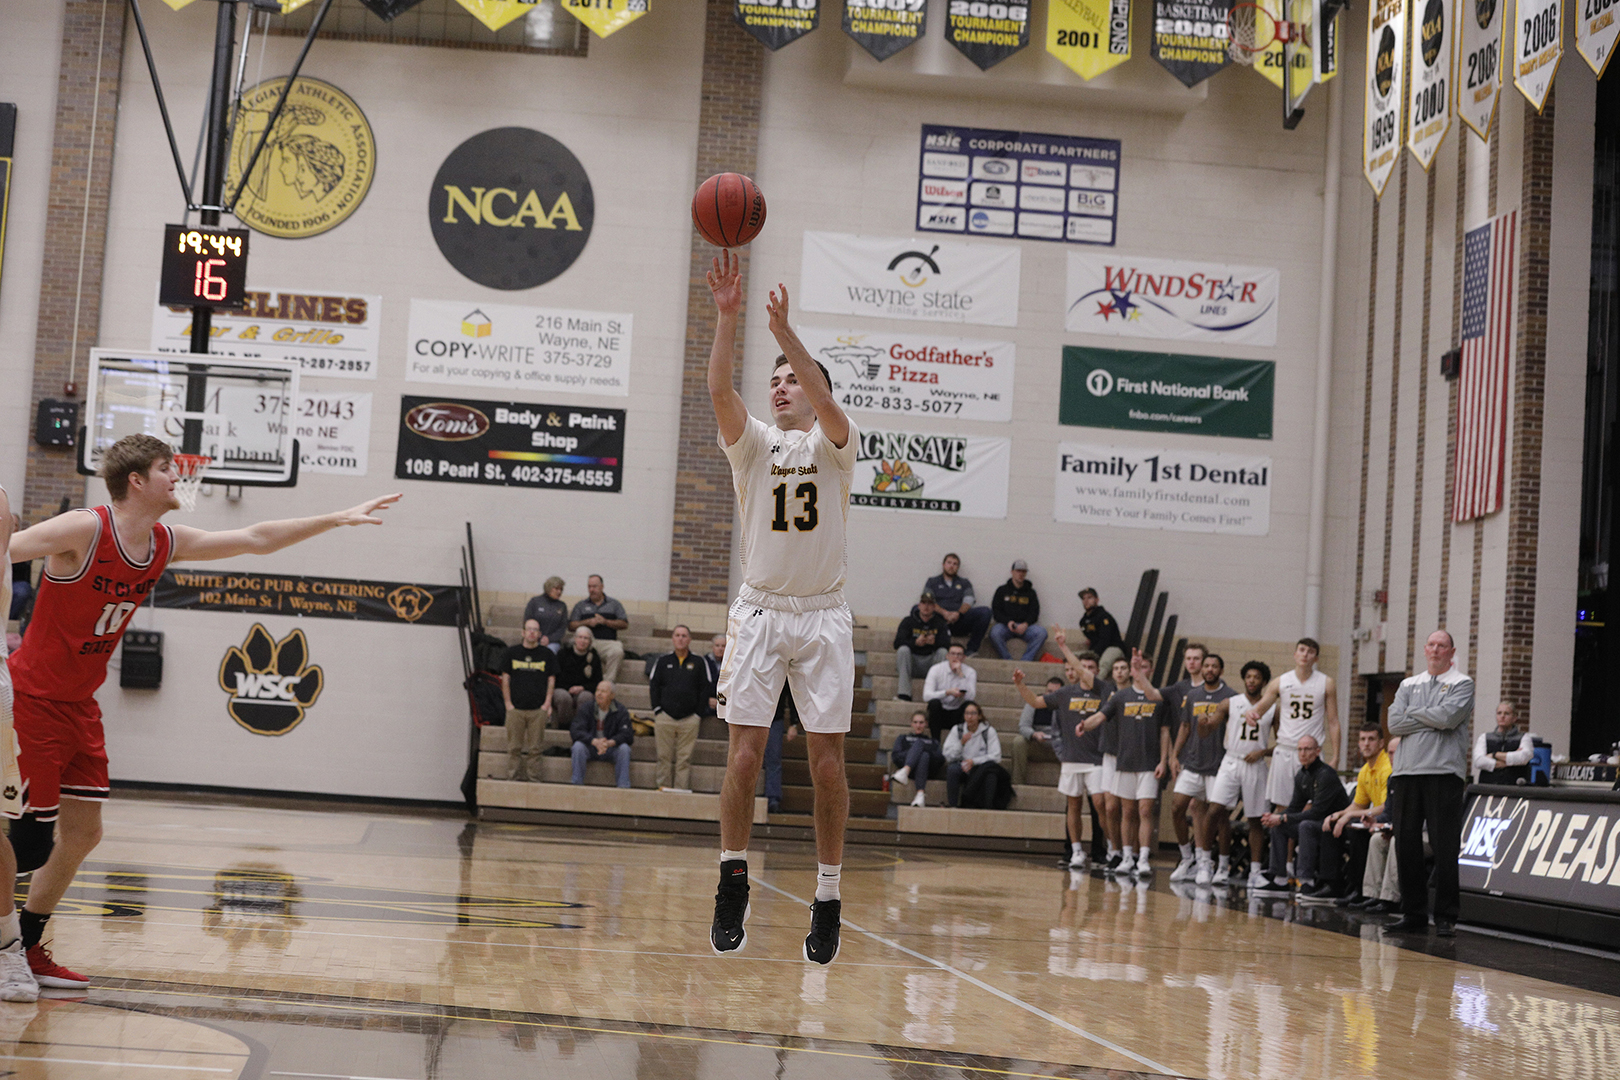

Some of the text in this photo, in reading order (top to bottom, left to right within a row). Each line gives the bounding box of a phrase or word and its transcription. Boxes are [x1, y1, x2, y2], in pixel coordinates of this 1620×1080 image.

[738, 4, 816, 19] TOURNAMENT
[847, 6, 924, 24] TOURNAMENT
[950, 0, 1028, 21] 2006
[1156, 2, 1229, 22] BASKETBALL
[745, 16, 813, 30] CHAMPIONS
[851, 20, 917, 38] CHAMPIONS
[950, 15, 1027, 34] TOURNAMENT
[1155, 18, 1231, 39] 2000
[1523, 2, 1557, 58] 2006
[953, 29, 1020, 47] CHAMPIONS
[1056, 29, 1099, 48] 2001
[1155, 33, 1230, 51] TOURNAMENT
[1158, 47, 1224, 64] CHAMPIONS
[1467, 37, 1498, 90] 2005
[1414, 78, 1445, 127] 2000
[297, 83, 354, 121] ATHLETIC
[337, 124, 367, 211] ASSOCIATION
[968, 138, 1047, 155] CORPORATE
[1049, 145, 1117, 160] PARTNERS
[924, 185, 964, 198] Wilson
[443, 184, 583, 231] NCAA
[250, 207, 331, 231] FOUNDED 1906
[928, 215, 957, 225] NSIC
[178, 231, 242, 257] 19:44
[193, 258, 228, 301] 16
[847, 286, 973, 311] wayne state
[1200, 305, 1227, 316] LINES
[238, 325, 261, 340] &
[271, 328, 345, 345] Grille
[535, 314, 625, 335] 216 Main St.
[539, 332, 620, 351] Wayne, NE
[543, 351, 612, 369] 375-3729
[889, 343, 994, 368] Godfather's
[412, 362, 623, 388] For all your copying & office supply needs.
[888, 364, 940, 385] Pizza
[850, 383, 884, 393] Main
[888, 386, 904, 395] St.
[929, 388, 979, 401] Wayne,
[983, 393, 1000, 402] NE
[1116, 377, 1148, 394] First
[1150, 380, 1211, 399] National
[1213, 385, 1249, 402] Bank
[842, 393, 963, 415] 402-833-5077
[413, 408, 480, 435] Tom's
[494, 407, 617, 431] Body & Paint
[1129, 409, 1202, 424] fnbo.com/careers
[267, 421, 339, 439] Wane NE
[531, 432, 578, 453] Shop
[886, 432, 906, 460] N
[908, 434, 967, 472] SAVE
[405, 458, 614, 487] 108 Pearl St. 402-375-4555
[771, 463, 796, 478] Wayne
[1061, 454, 1268, 487] Family 1st Dental
[771, 481, 819, 533] 13
[850, 495, 959, 511] ROCERY STORE
[1076, 486, 1250, 507] www.familyfirstdental.com
[1114, 506, 1140, 519] Your
[1143, 508, 1178, 524] Family
[1181, 512, 1216, 524] Comes
[92, 575, 113, 595] ST.
[174, 573, 385, 599] WHITE DOG PUB & CATERING
[199, 592, 357, 613] 102 Main St Wayne, NE
[93, 600, 136, 637] 10
[234, 672, 301, 700] WSC
[1290, 701, 1314, 719] 35
[1240, 721, 1260, 741] 12
[1556, 765, 1596, 781] WILDCATS
[1462, 816, 1513, 858] WSC
